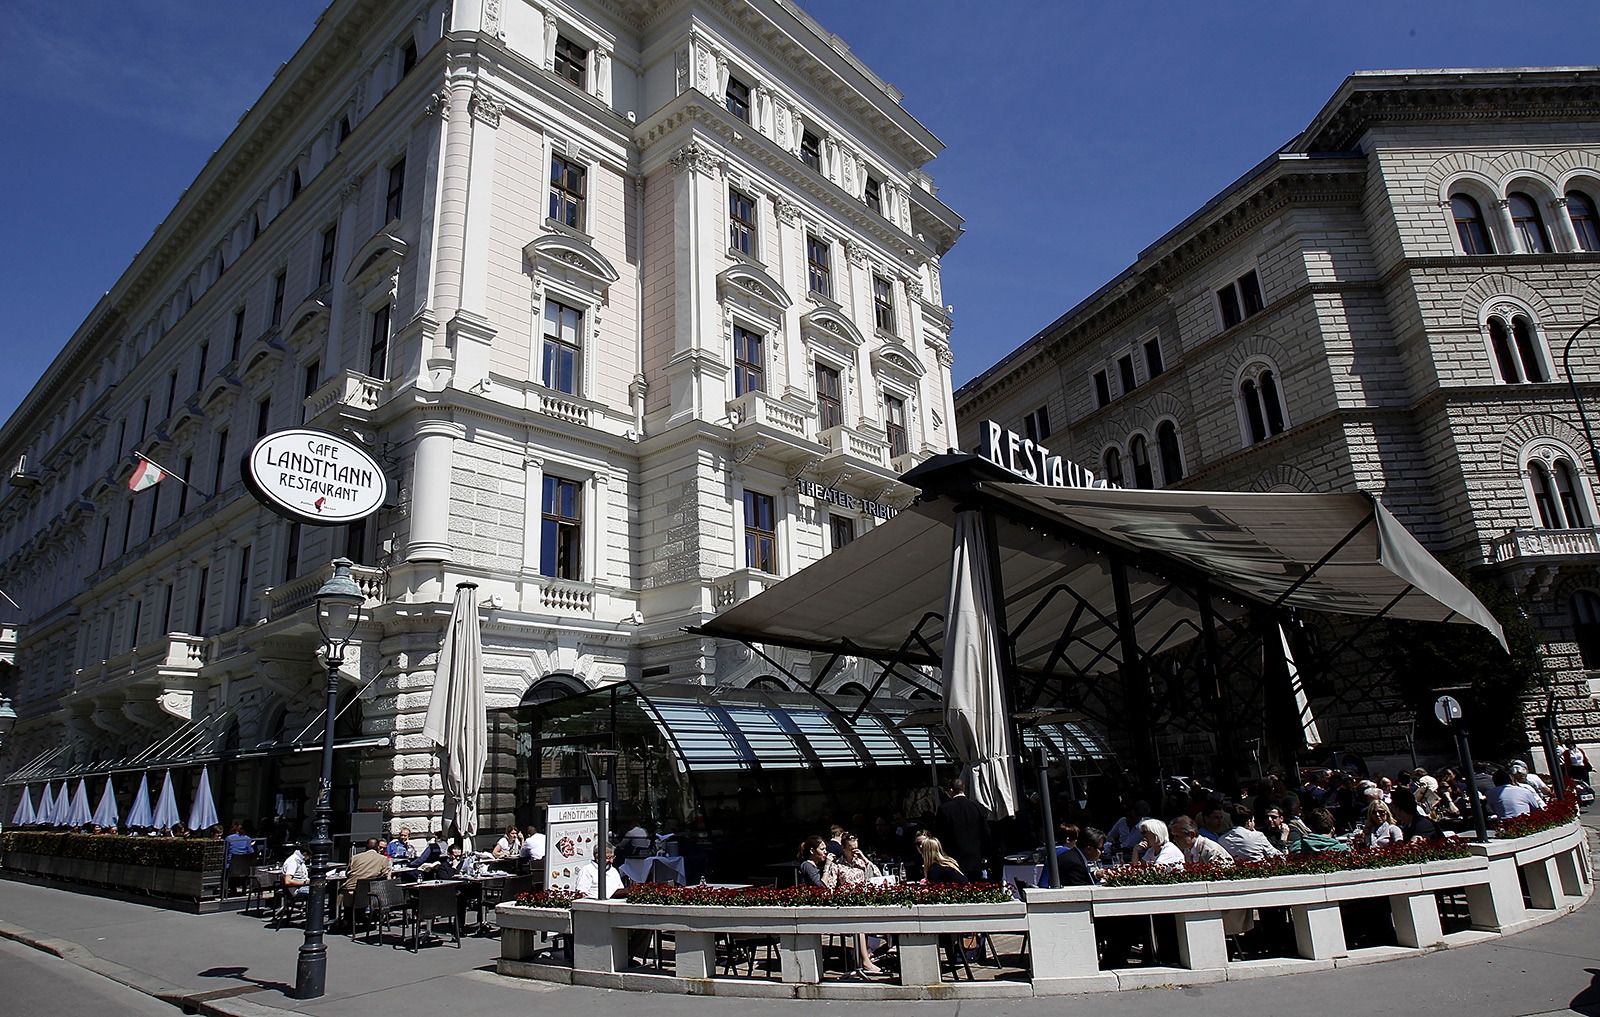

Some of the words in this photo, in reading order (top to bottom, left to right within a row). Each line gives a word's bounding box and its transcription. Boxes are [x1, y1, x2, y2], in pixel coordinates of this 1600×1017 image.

[307, 440, 339, 460] CAFE
[986, 419, 1122, 489] RESTAUR
[266, 446, 373, 489] LANDTMANN
[279, 472, 359, 502] RESTAURANT
[797, 478, 856, 509] THEATER
